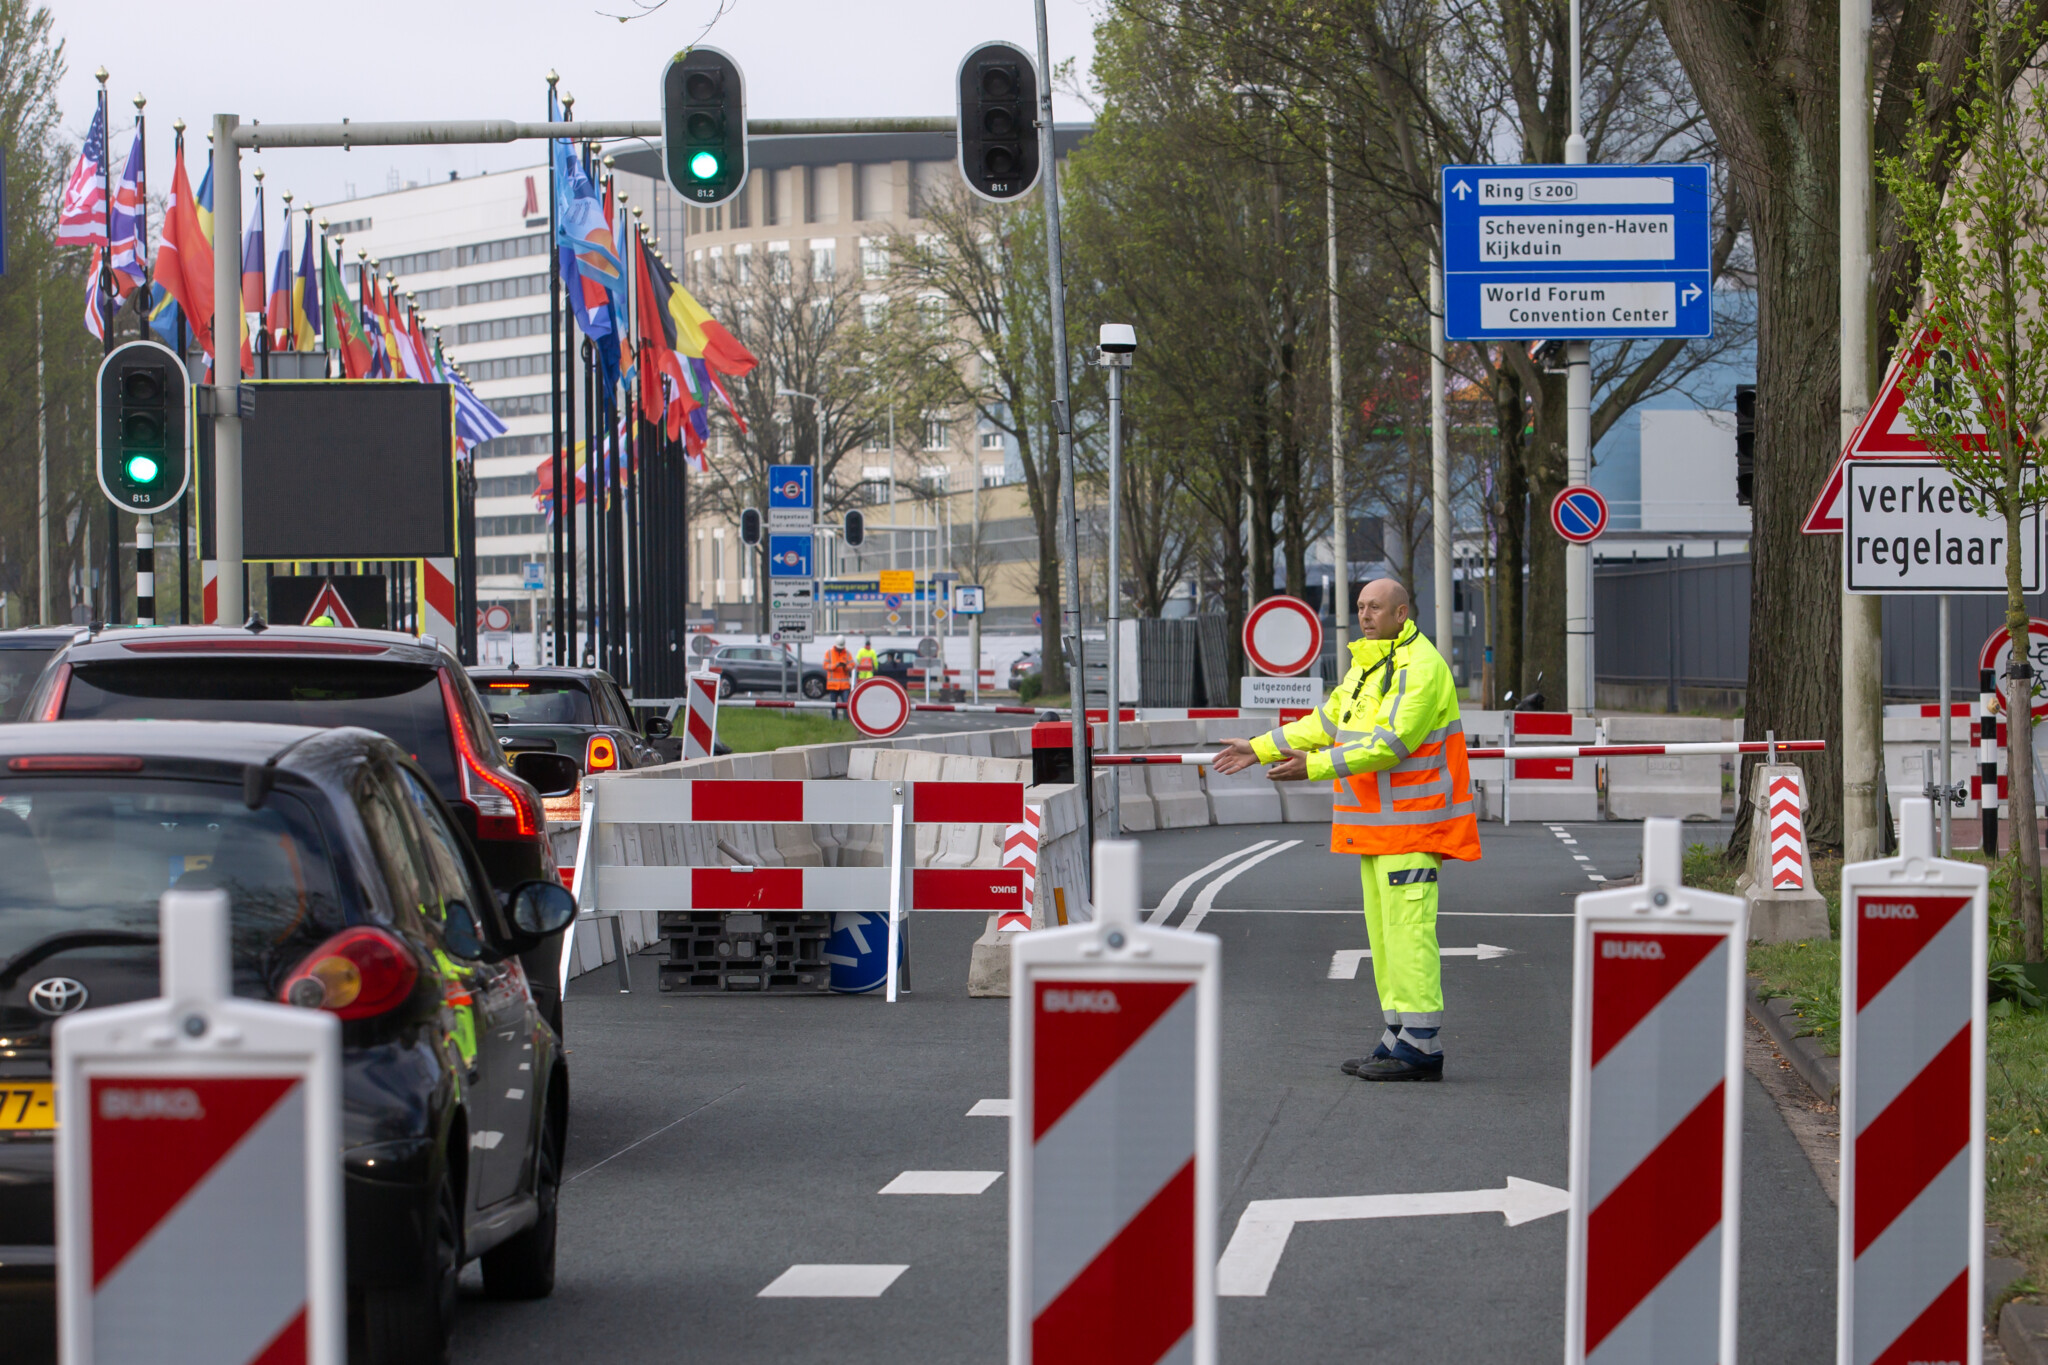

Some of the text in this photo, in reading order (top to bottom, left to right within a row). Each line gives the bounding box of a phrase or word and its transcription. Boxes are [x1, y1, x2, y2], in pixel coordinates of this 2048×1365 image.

[697, 189, 715, 198] 81.2
[991, 183, 1008, 192] 81.1
[1485, 184, 1574, 201] Ring S 200
[1485, 219, 1669, 238] Scheveningen-Haven
[1486, 240, 1562, 259] Kijkduin
[1487, 287, 1606, 302] World Forum
[1509, 307, 1669, 323] Convention Center
[132, 494, 151, 503] 81.3
[1857, 527, 2004, 577] regelaar
[1253, 682, 1312, 693] uitgezonderd
[1253, 695, 1311, 705] bouwverkeer
